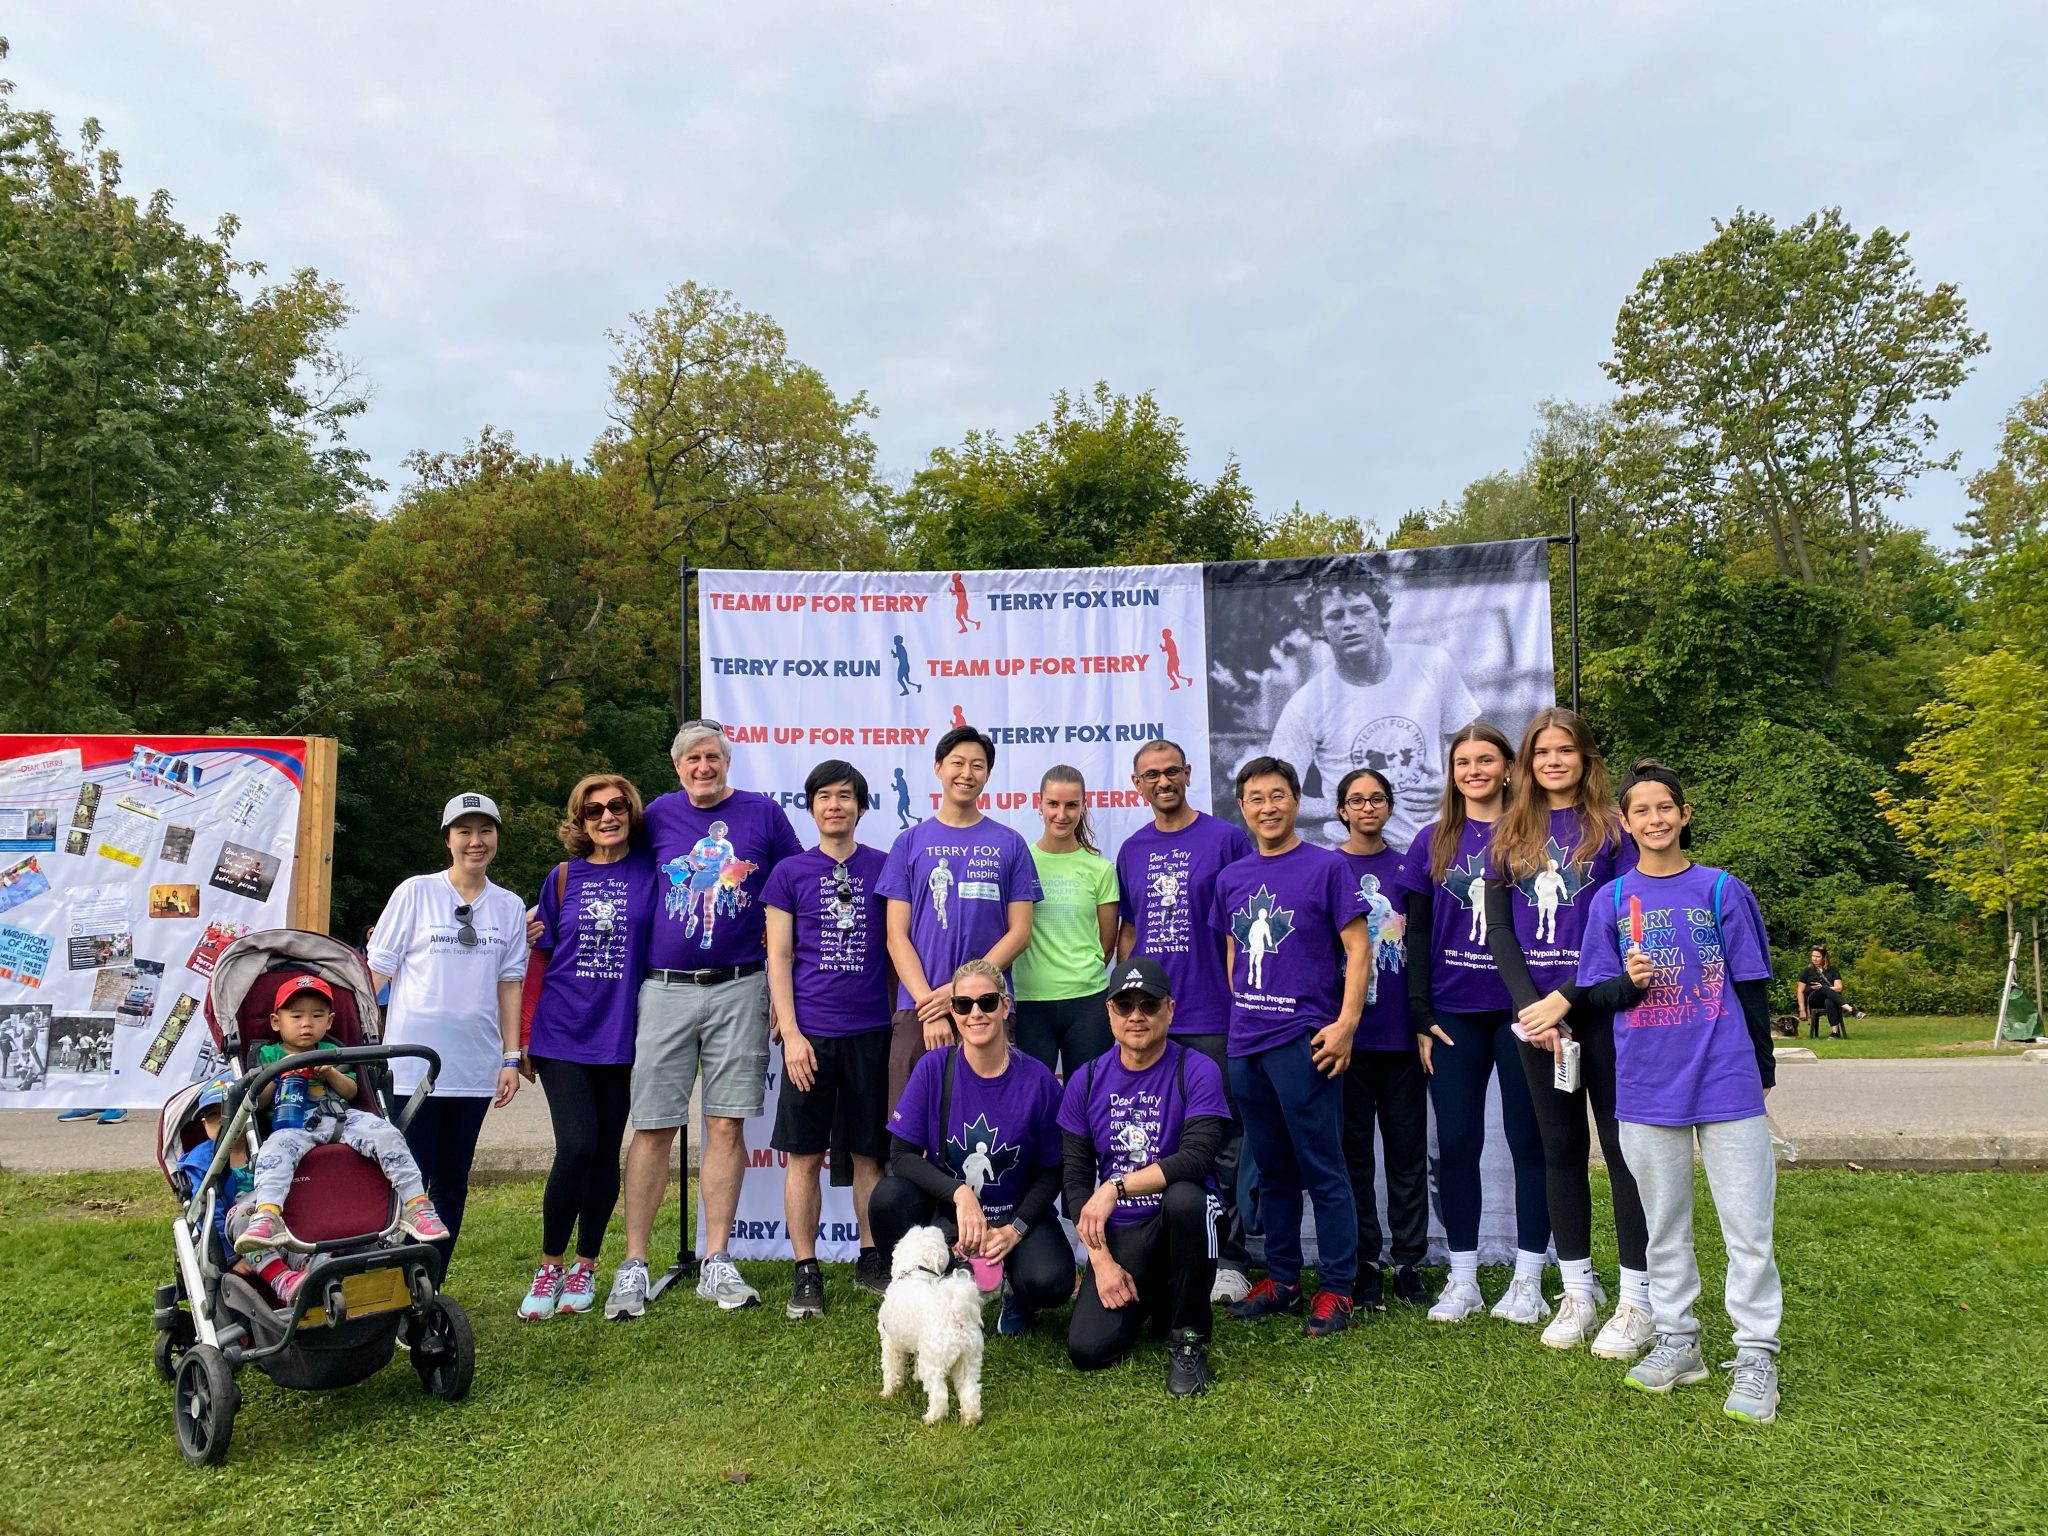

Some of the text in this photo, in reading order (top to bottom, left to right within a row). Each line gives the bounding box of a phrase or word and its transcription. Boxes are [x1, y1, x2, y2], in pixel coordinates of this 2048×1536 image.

[710, 593, 928, 612] TEAM UP FOR TERRY
[987, 589, 1159, 611] TERRY FOX RUN
[711, 657, 880, 676] TERRY FOX RUN
[927, 654, 1150, 676] TEAM UP FOR TERRY
[722, 725, 930, 744] EAM UP FOR TERRY
[988, 723, 1164, 744] TERRY FOX RUN
[1359, 720, 1412, 744] TERRY FOX
[781, 792, 806, 809] FO
[929, 793, 991, 810] TM
[997, 793, 1027, 810] UP
[926, 846, 1000, 858] TERRY FOX
[1149, 849, 1191, 862] Dear Terry
[968, 858, 1000, 868] Aspire.
[966, 869, 1000, 880] Inspire.
[1173, 871, 1188, 879] ERRY
[607, 879, 628, 890] Terry
[2, 928, 47, 946] MARATHON
[430, 935, 458, 944] Always
[1690, 927, 1719, 945] OX
[1464, 952, 1493, 960] Hypoxia
[1530, 949, 1560, 958] Hypoxia
[1562, 950, 1579, 958] Prog
[1699, 945, 1724, 963] OX
[24, 960, 42, 970] MILES
[196, 956, 215, 970] Terry
[576, 970, 623, 979] DEAR TERRY
[1702, 962, 1724, 982] OX
[1267, 995, 1296, 1004] Program
[1638, 986, 1683, 1007] RRY
[1624, 1006, 1684, 1027] ERRY
[1110, 1091, 1161, 1107] Dear Terry
[1111, 1108, 1126, 1117] Dear
[1140, 1122, 1160, 1133] ERRY
[729, 1220, 780, 1239] ERRY
[832, 1223, 860, 1241] RU
